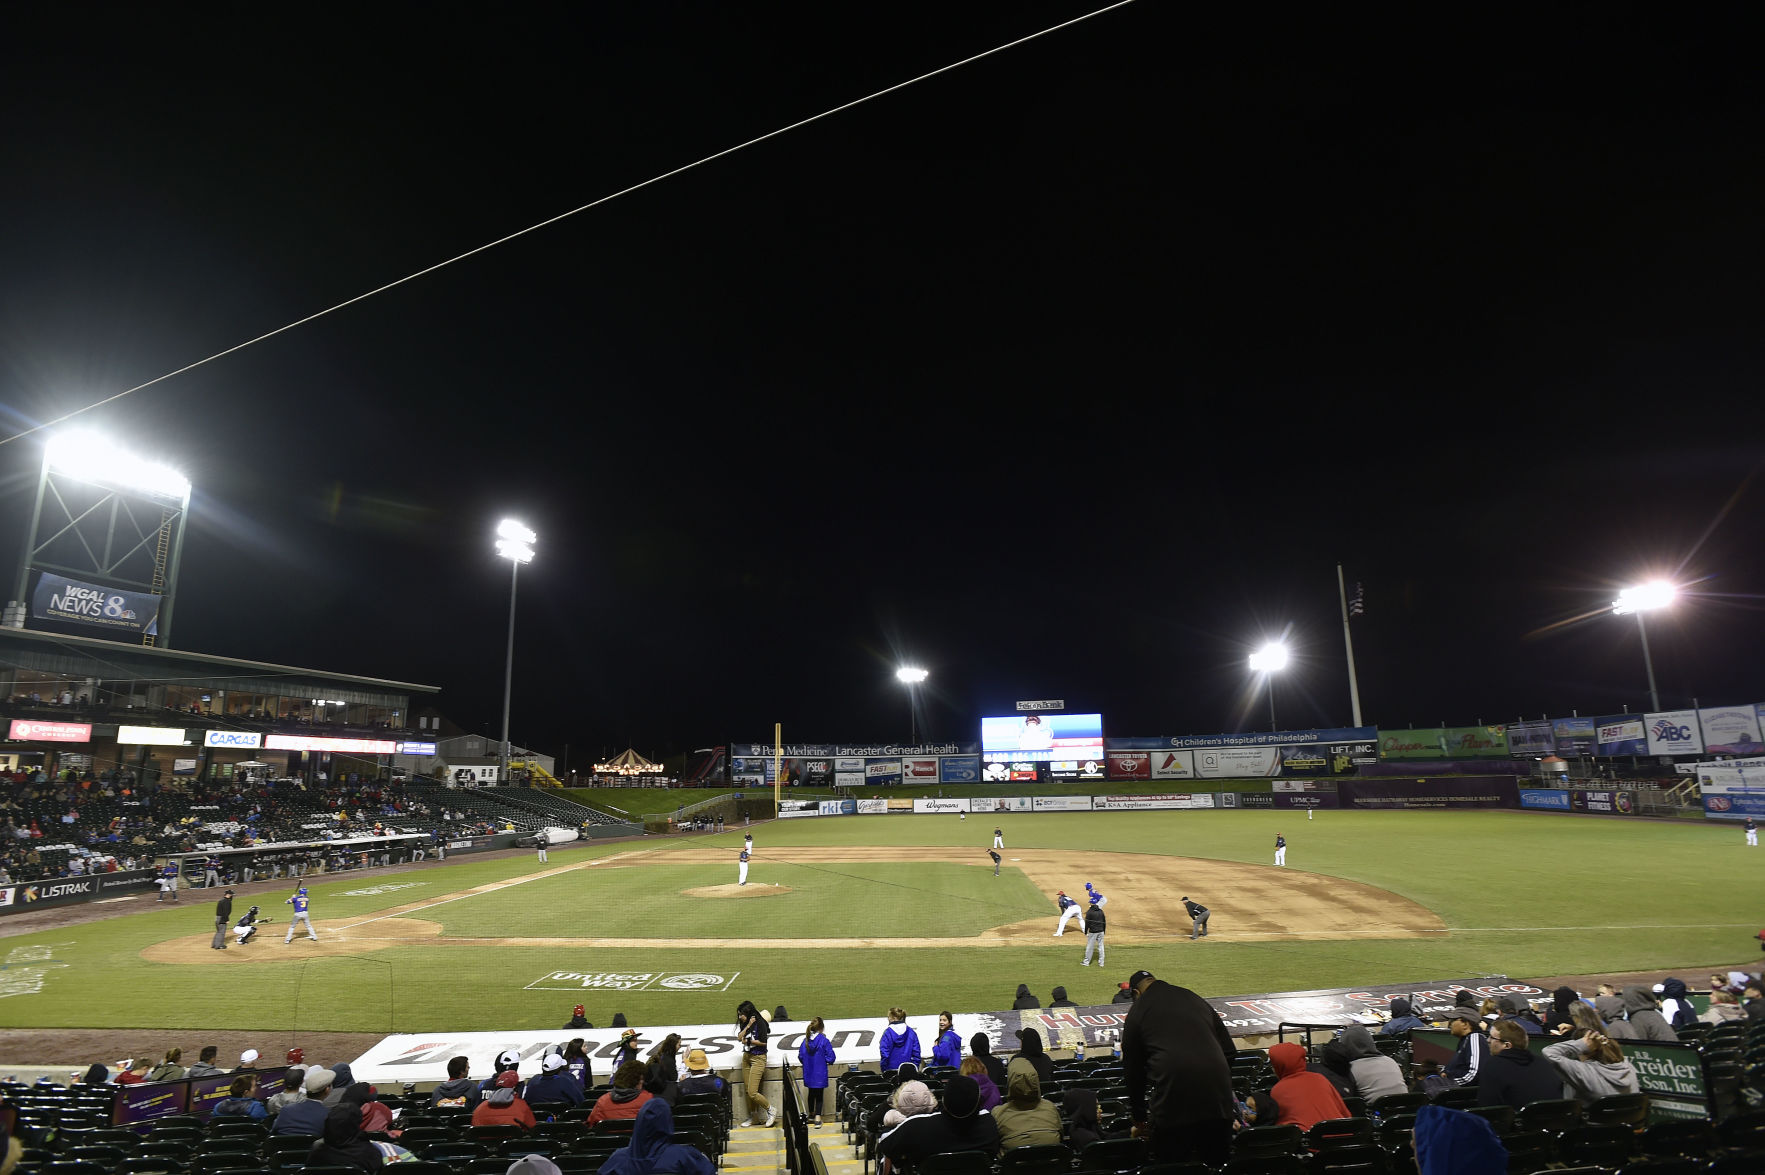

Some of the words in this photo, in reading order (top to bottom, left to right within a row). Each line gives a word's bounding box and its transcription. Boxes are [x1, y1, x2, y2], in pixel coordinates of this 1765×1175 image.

[65, 585, 105, 603] WGAL
[50, 594, 102, 617] NEWS
[104, 596, 125, 617] 8
[209, 732, 257, 745] CARGAS
[1656, 725, 1691, 742] ABC
[1184, 738, 1222, 746] Children's
[1223, 737, 1257, 745] Hospital
[1268, 734, 1318, 743] Philadelphia
[786, 745, 828, 756] Medicine
[836, 746, 881, 755] Lancaster
[884, 745, 922, 755] General
[926, 744, 959, 754] Health
[1330, 746, 1353, 754] LIFT,
[1355, 744, 1375, 753] INC.
[1586, 792, 1609, 801] PLANET
[926, 800, 959, 813] Wegmans
[1588, 801, 1612, 811] FITNESS
[41, 881, 91, 899] LISTRAK
[551, 972, 654, 981] United
[581, 980, 645, 990] Way
[1642, 1076, 1673, 1093] Son,
[1673, 1078, 1703, 1095] Inc.
